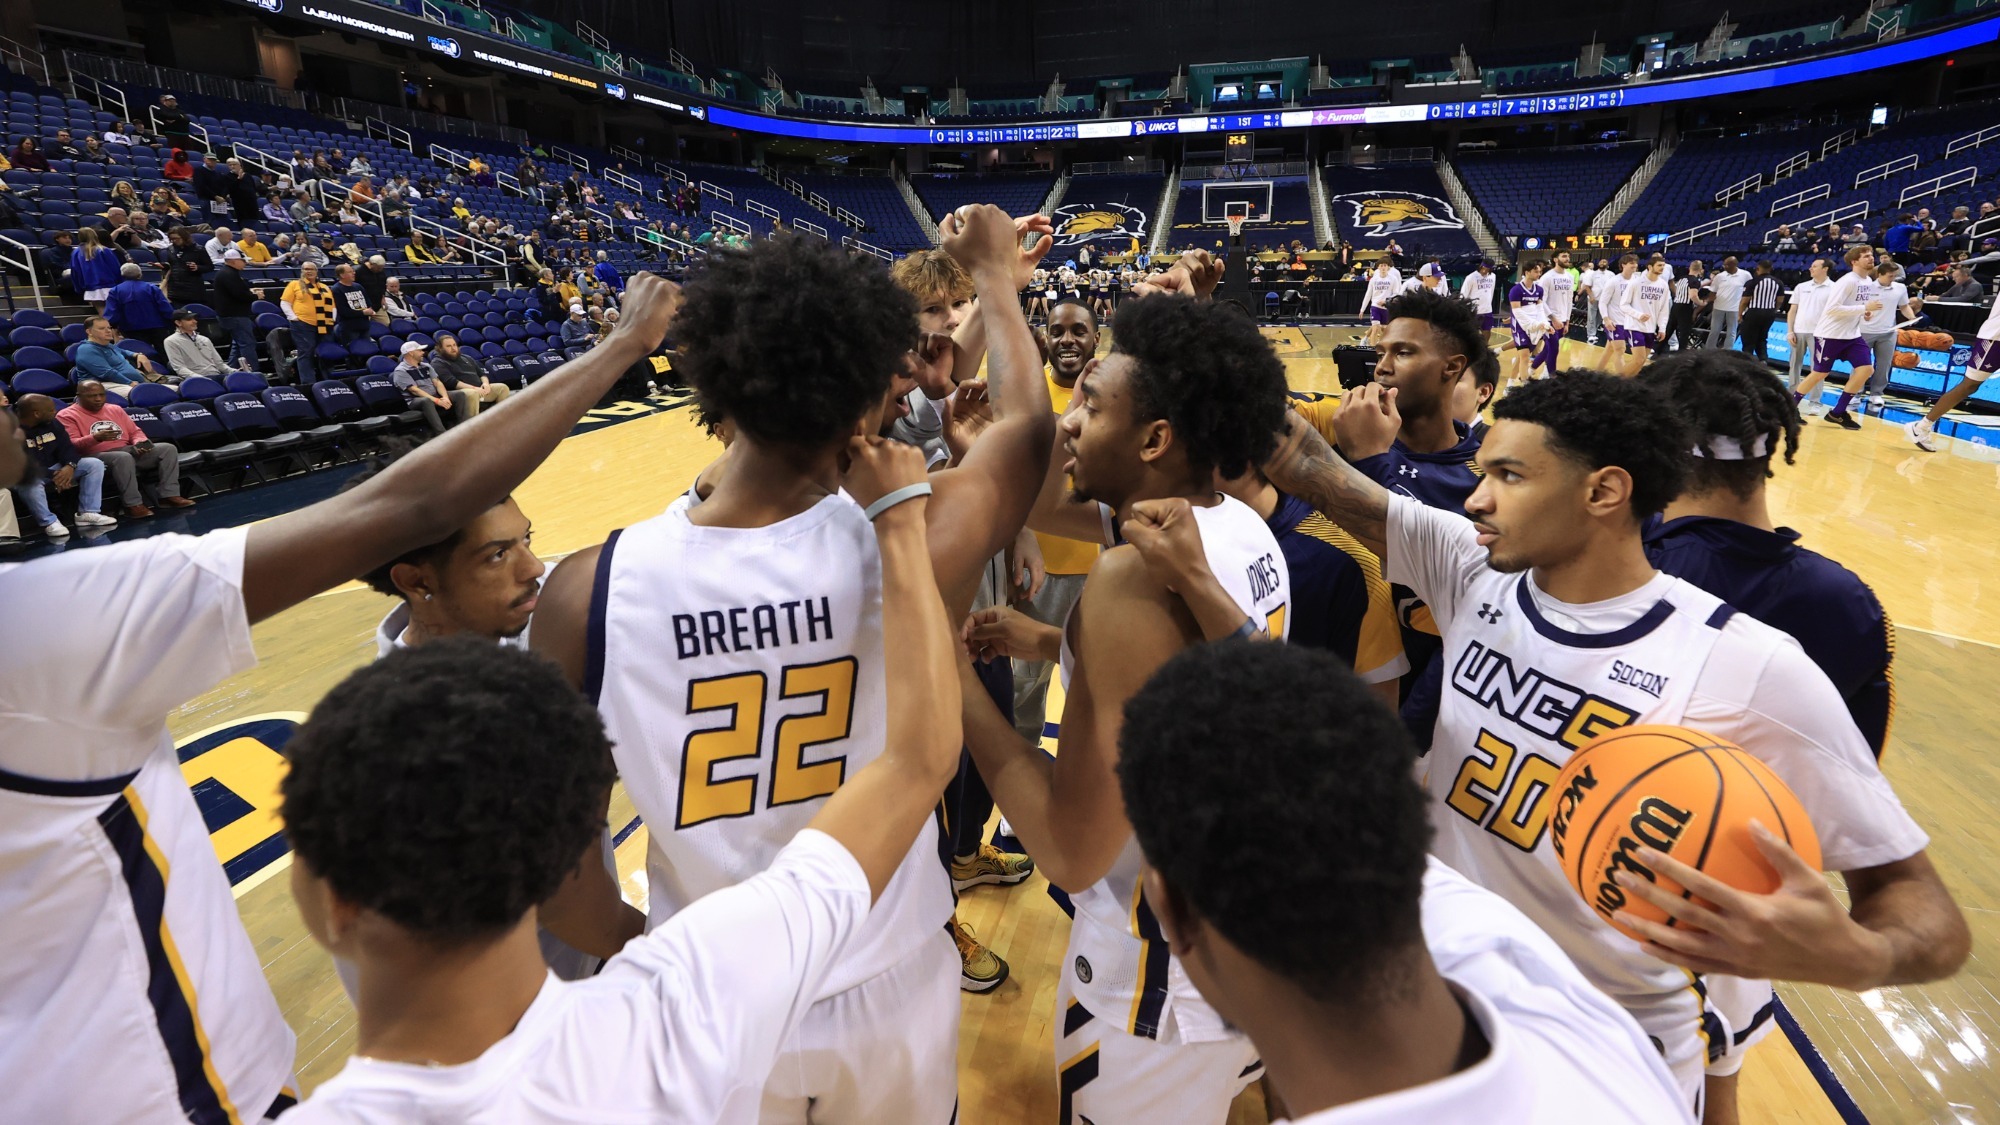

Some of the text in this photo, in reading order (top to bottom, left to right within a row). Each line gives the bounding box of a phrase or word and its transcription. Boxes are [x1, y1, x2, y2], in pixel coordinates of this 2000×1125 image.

[302, 6, 414, 41] LAJEAN MORROW-SMITH
[473, 50, 488, 61] THE
[488, 54, 517, 69] OFFICIAL
[518, 62, 543, 74] DENTIST
[543, 68, 552, 77] OF
[1222, 65, 1262, 73] FINANCIAL
[1542, 99, 1556, 111] 13
[1579, 95, 1594, 108] 21
[1431, 106, 1440, 118] 0
[1468, 104, 1476, 115] 4
[1506, 102, 1514, 113] 7
[1238, 117, 1251, 126] 1ST
[1327, 112, 1366, 122] Furman
[1149, 122, 1176, 132] UNCG
[936, 132, 944, 142] 0
[967, 132, 974, 142] 3
[993, 131, 1003, 141] 11
[1023, 129, 1034, 140] 12
[1051, 128, 1063, 138] 22
[1641, 286, 1665, 294] FURMAN
[672, 597, 833, 660] BREATH
[1608, 660, 1669, 698] SOCON
[1452, 640, 1642, 751] UNCG
[674, 655, 859, 830] 22
[1445, 727, 1561, 853] 20
